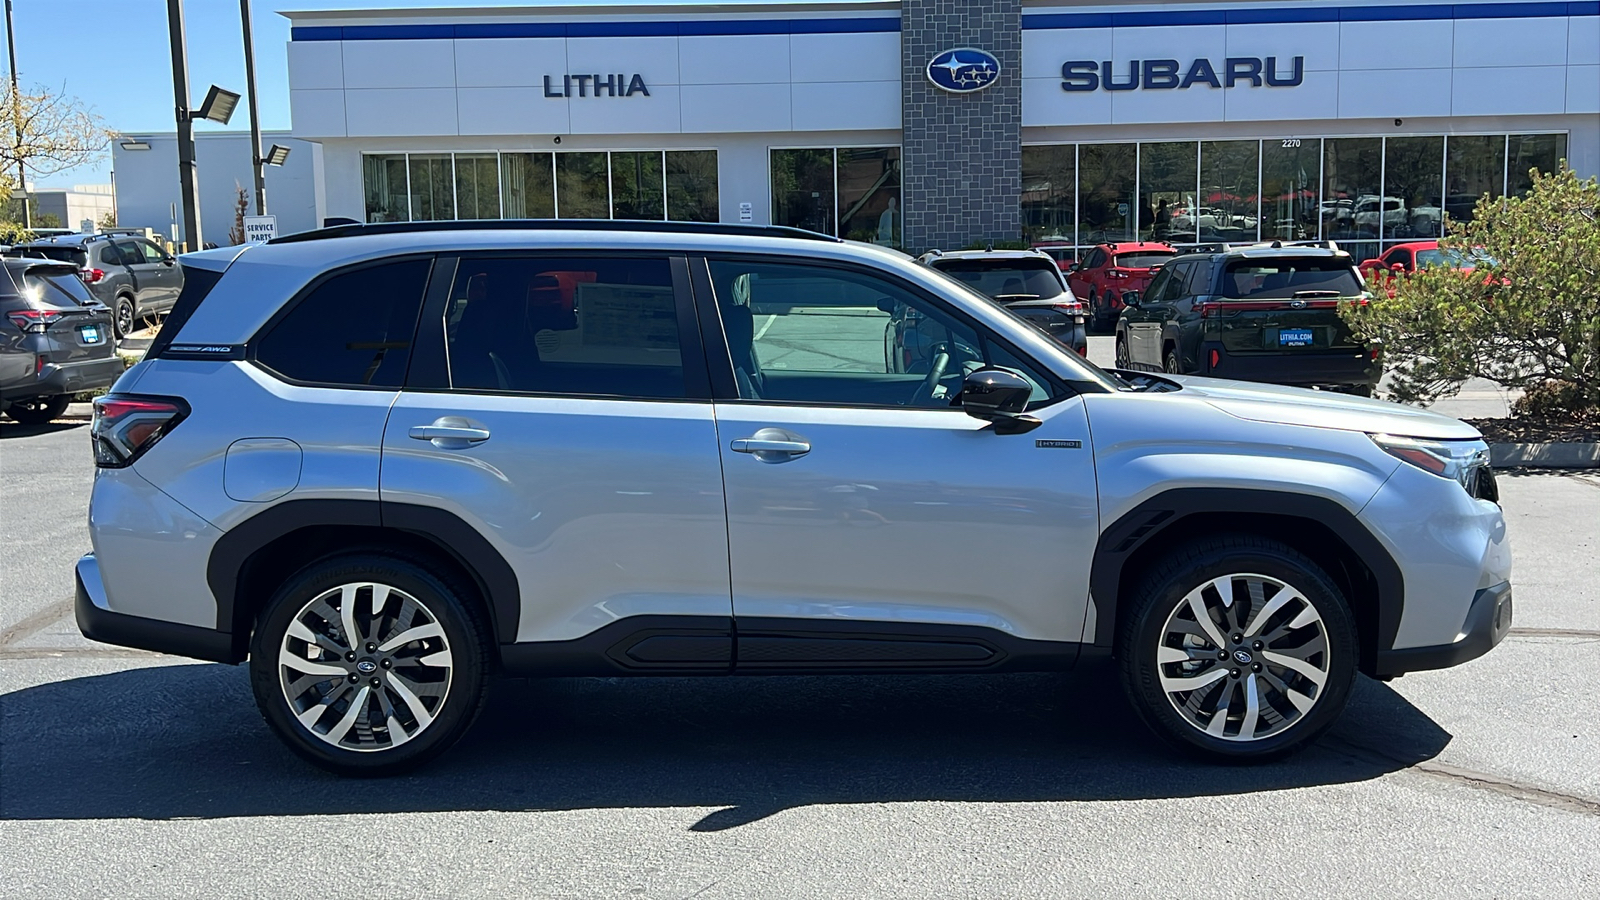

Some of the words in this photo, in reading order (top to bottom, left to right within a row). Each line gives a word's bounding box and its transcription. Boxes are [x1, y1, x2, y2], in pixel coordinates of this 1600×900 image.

[1061, 56, 1304, 91] SUBARU
[543, 74, 650, 98] LITHIA
[1282, 139, 1301, 147] 2270
[251, 233, 271, 241] PARTS
[1280, 333, 1312, 341] LITHIA.COM
